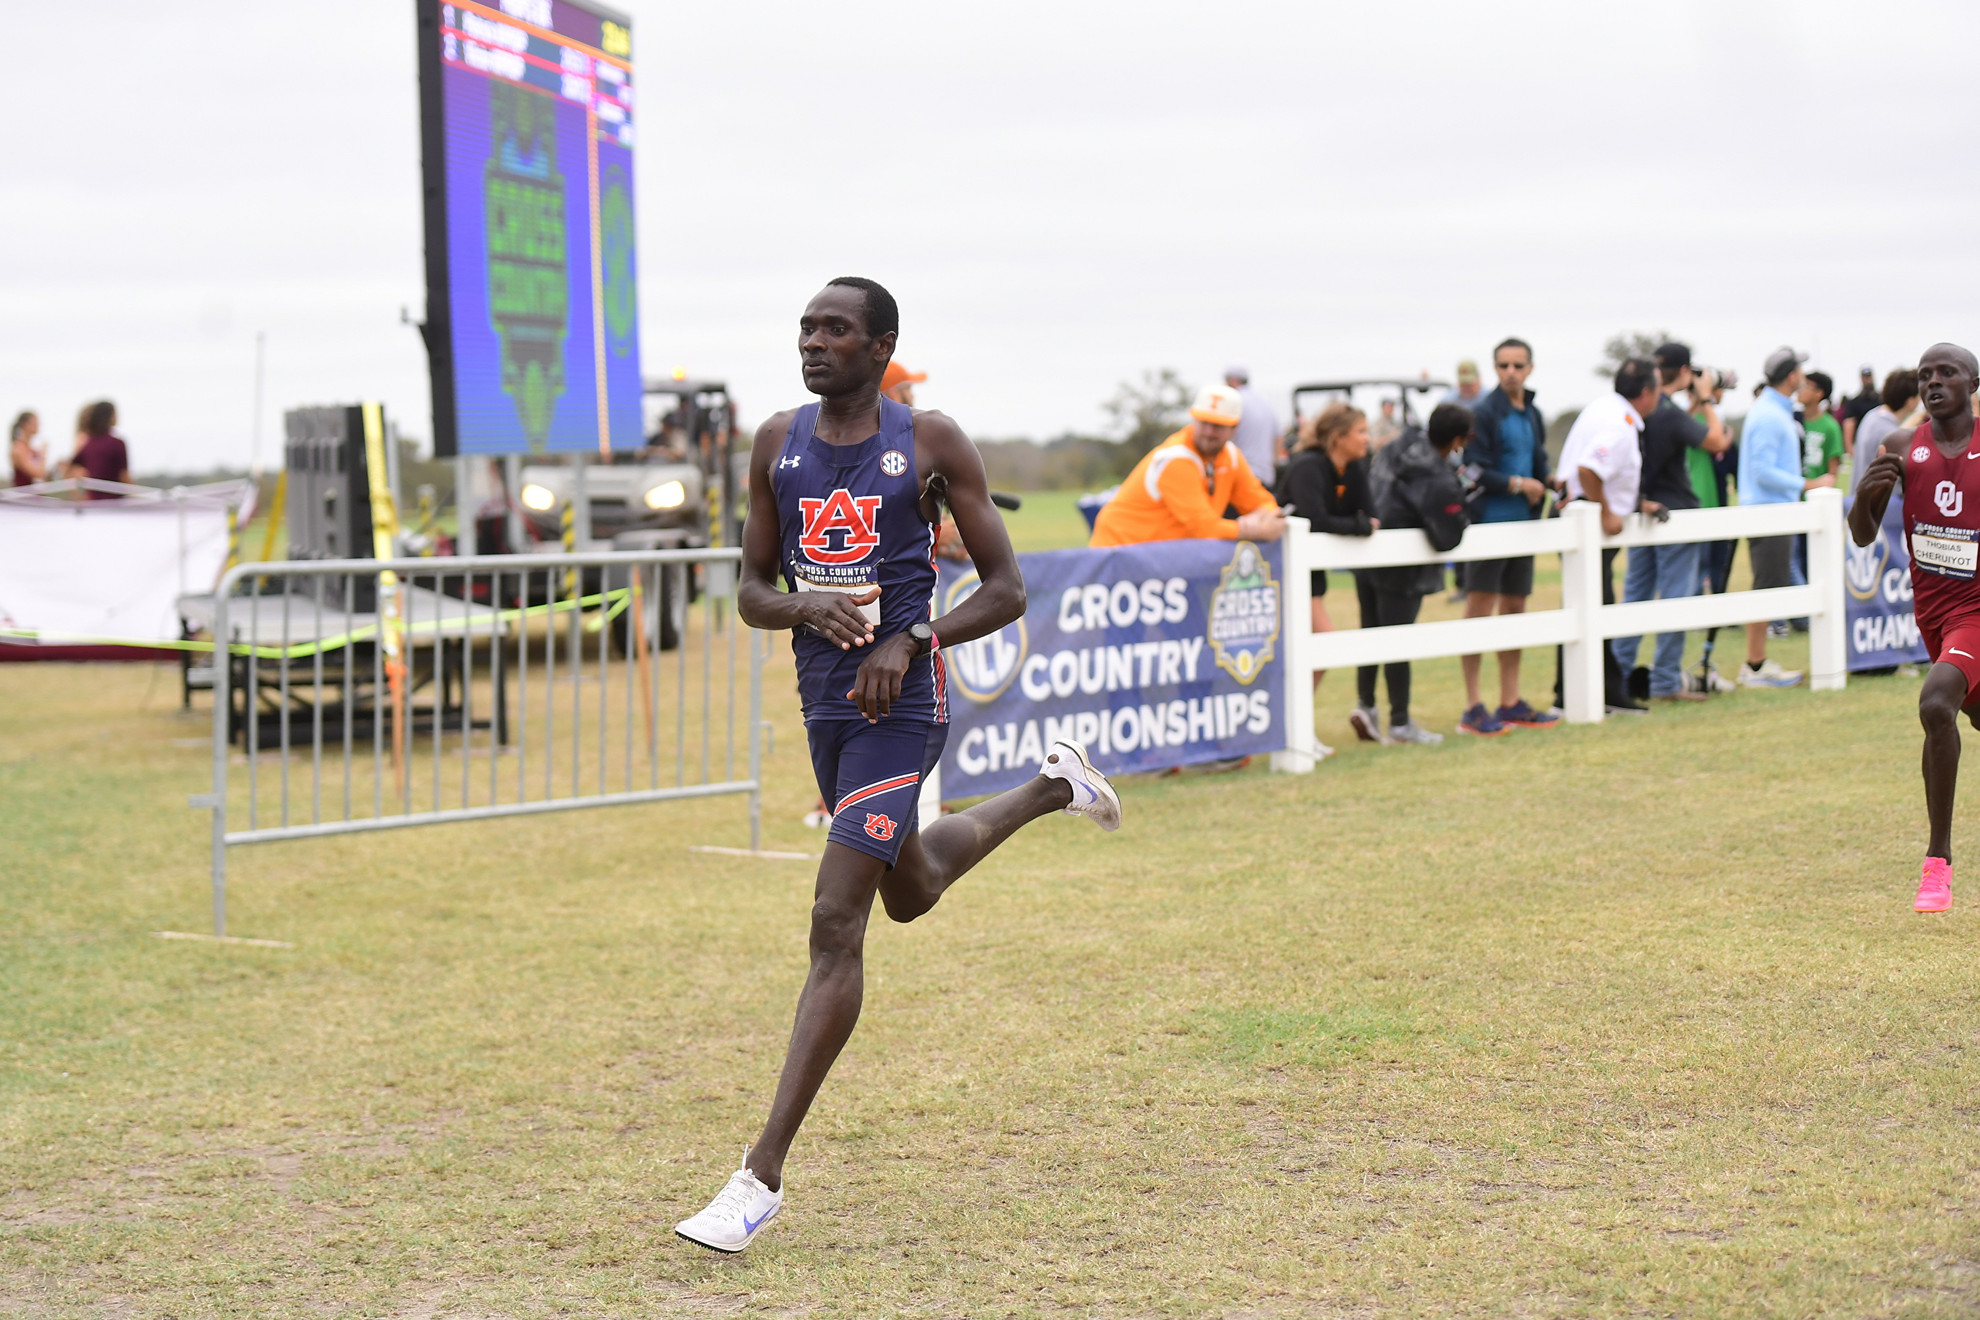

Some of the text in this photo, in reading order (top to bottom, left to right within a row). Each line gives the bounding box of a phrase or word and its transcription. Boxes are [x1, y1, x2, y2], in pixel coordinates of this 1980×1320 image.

[883, 452, 905, 474] SEC
[1934, 480, 1963, 517] OU
[1926, 540, 1961, 552] THOBIAS
[1915, 549, 1971, 566] CHERUIYOT
[807, 573, 867, 584] CHAMPIONSHIPS
[829, 566, 871, 576] COUNTRY
[1058, 577, 1188, 634] CROSS
[1020, 636, 1205, 701] COUNTRY
[956, 690, 1271, 776] CHAMPIONSHIPS
